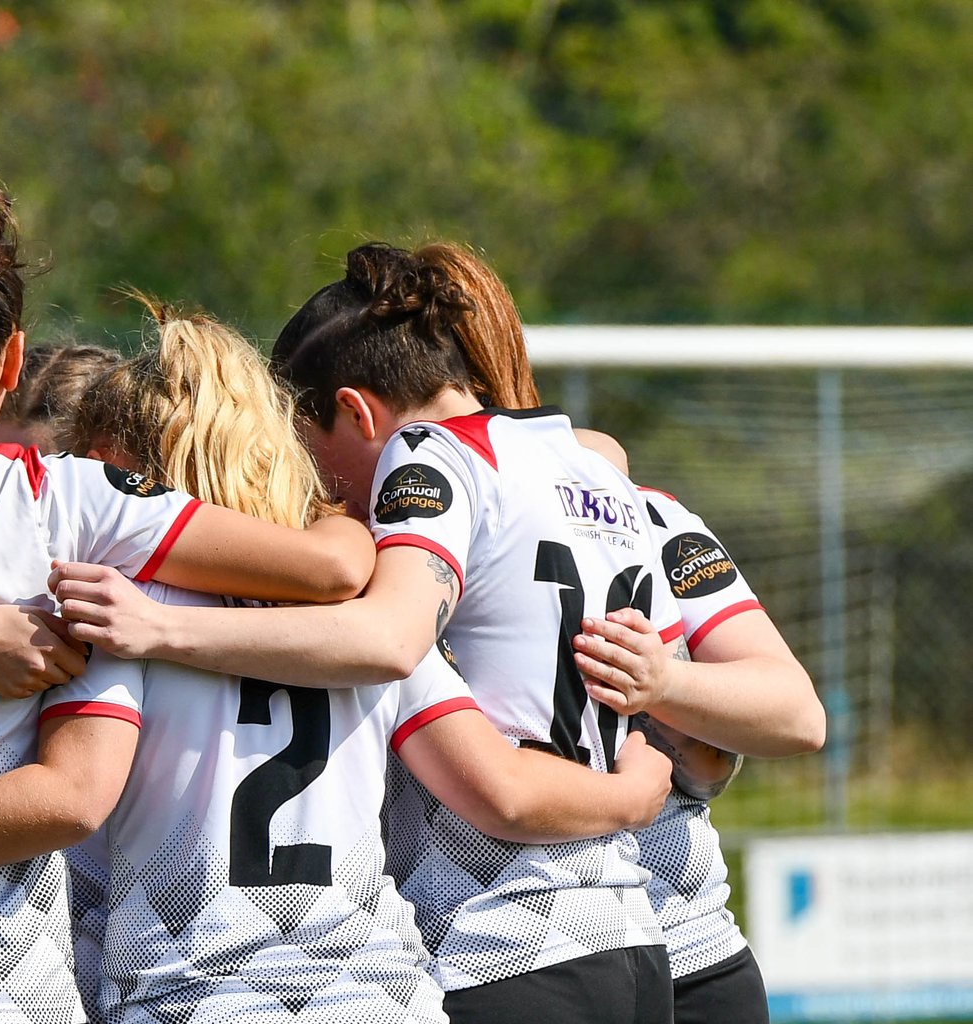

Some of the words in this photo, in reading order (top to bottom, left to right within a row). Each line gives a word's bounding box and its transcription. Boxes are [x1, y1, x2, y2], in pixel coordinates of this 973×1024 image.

[376, 496, 444, 518] Mortgages
[382, 486, 441, 505] Cornwall
[671, 548, 725, 582] Cornwall
[673, 560, 735, 596] Mortgages
[229, 676, 333, 887] 2
